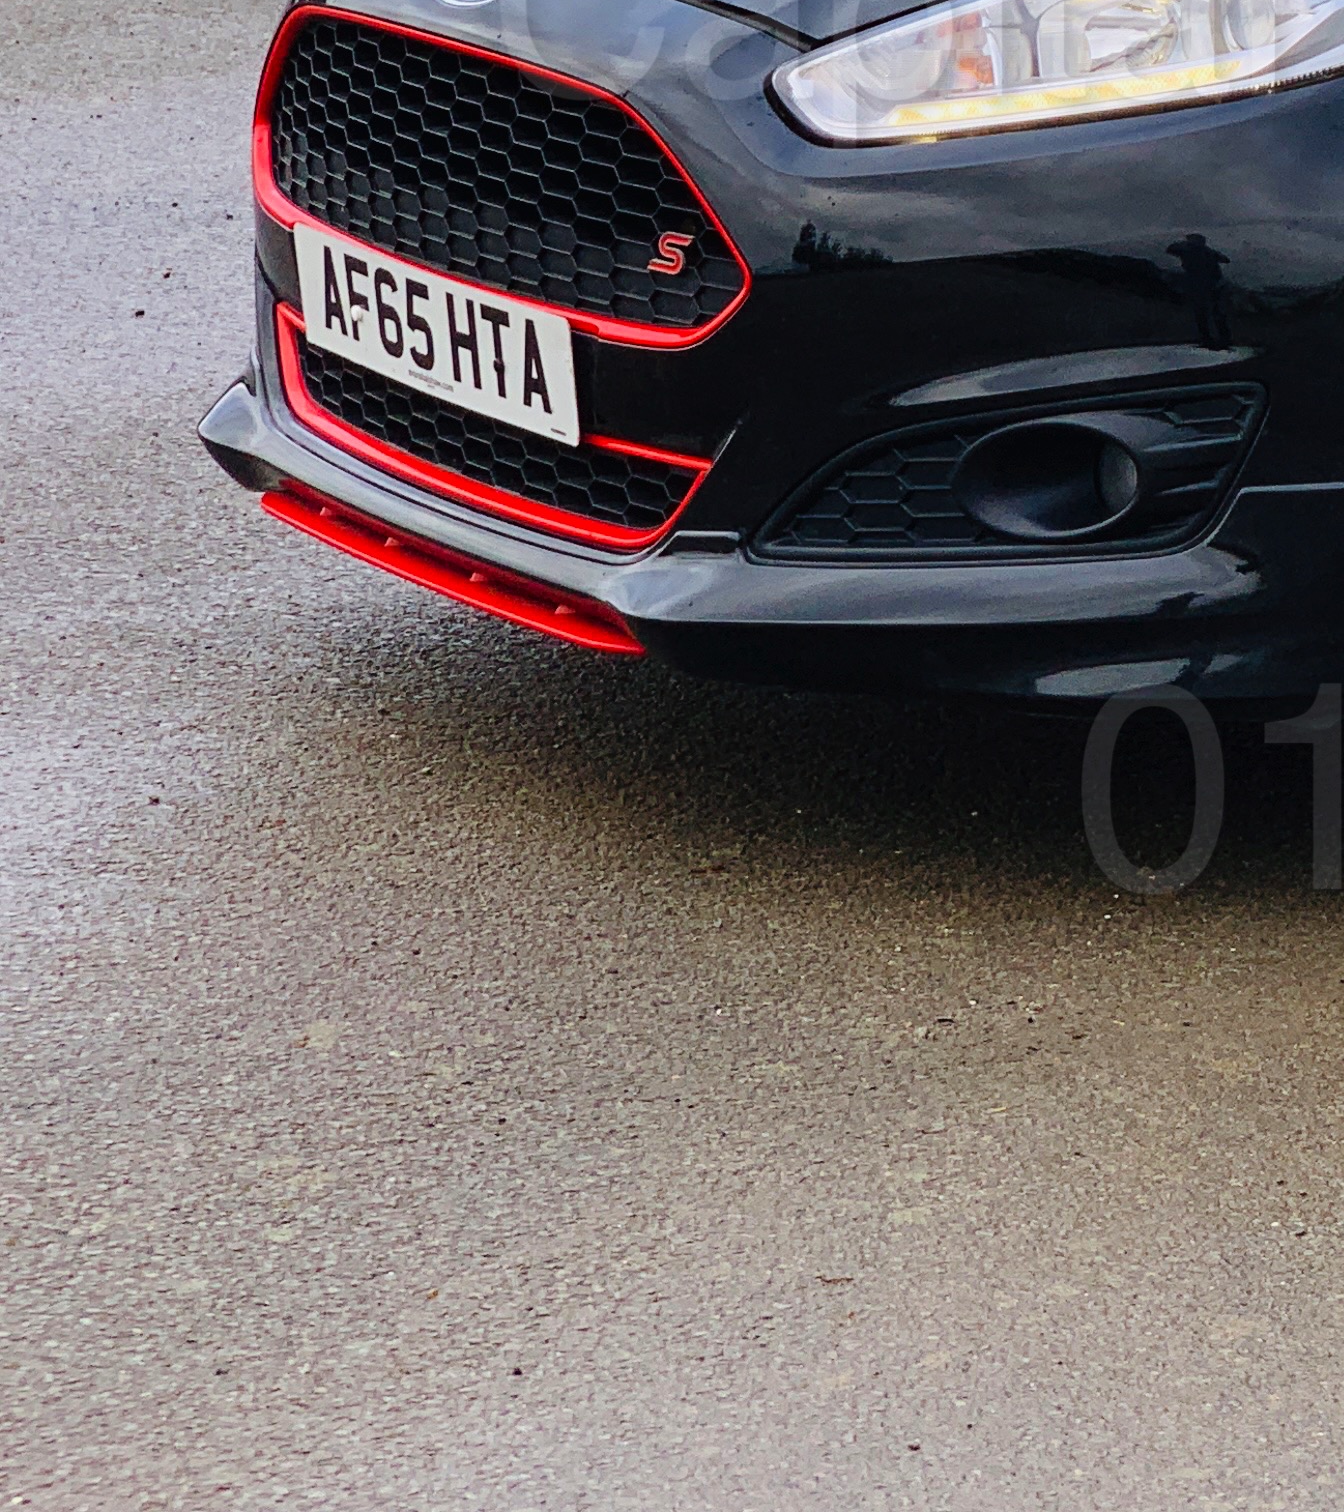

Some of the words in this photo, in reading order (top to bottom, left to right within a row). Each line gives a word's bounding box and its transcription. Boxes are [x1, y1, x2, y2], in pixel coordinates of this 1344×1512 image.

[646, 231, 695, 276] S
[322, 245, 436, 372] AF65
[445, 291, 553, 416] HTA
